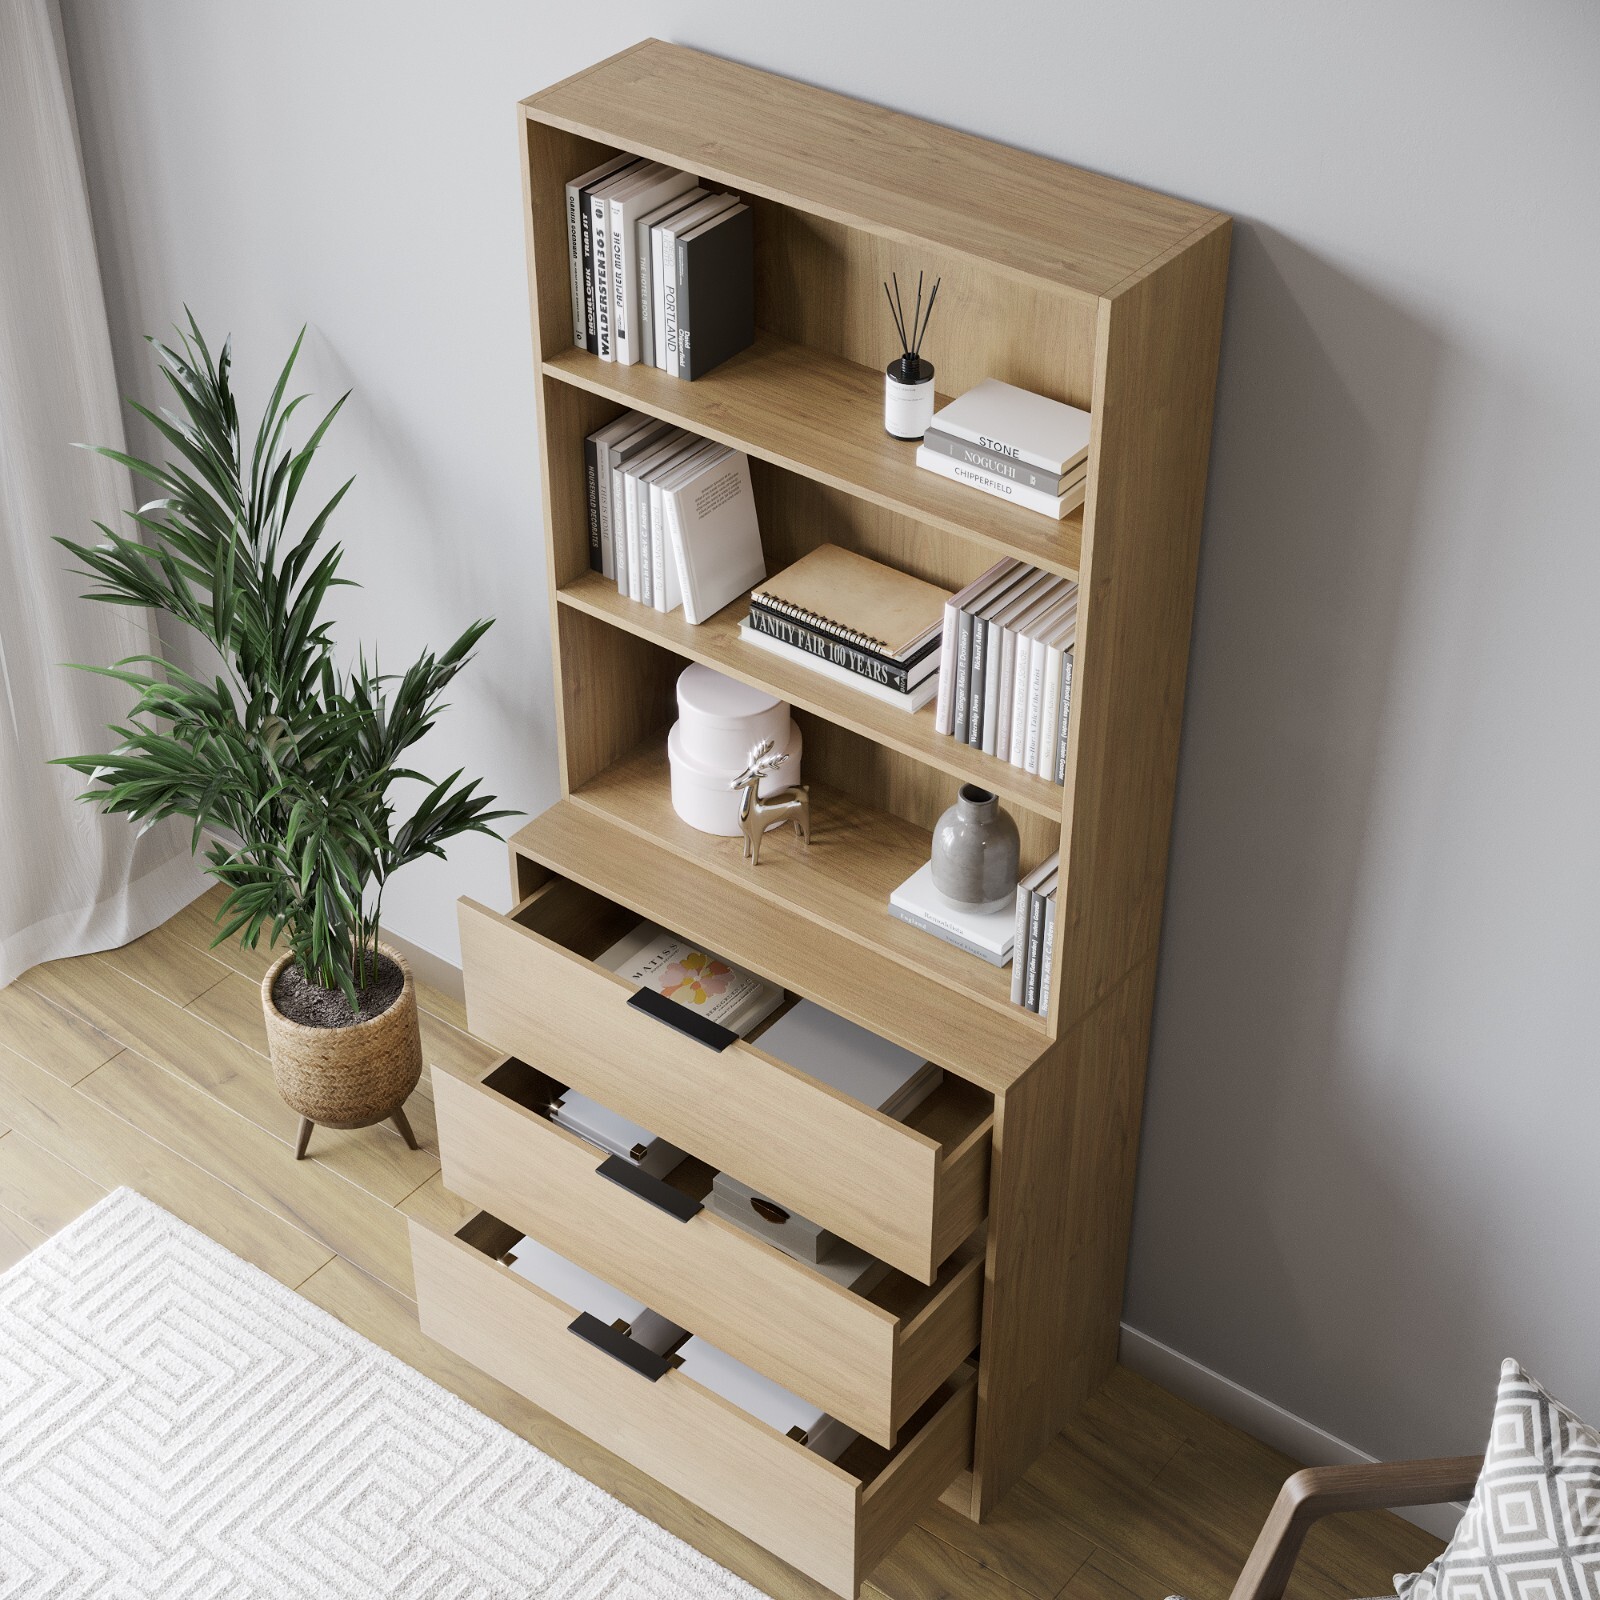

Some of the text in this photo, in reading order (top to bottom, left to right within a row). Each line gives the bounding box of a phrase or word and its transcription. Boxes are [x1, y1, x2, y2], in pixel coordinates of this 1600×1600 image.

[666, 285, 676, 352] PORTLAND
[979, 436, 1019, 459] STONE
[964, 450, 1016, 479] NOGUCHI
[954, 467, 1012, 494] CHIPPERFIELD
[588, 466, 599, 548] HOUSEHOLD DECORATES
[751, 608, 799, 644] VANITY
[798, 629, 826, 658] FAIR
[829, 642, 846, 666] 100
[849, 650, 888, 684] YEARS
[974, 645, 982, 670] Richard
